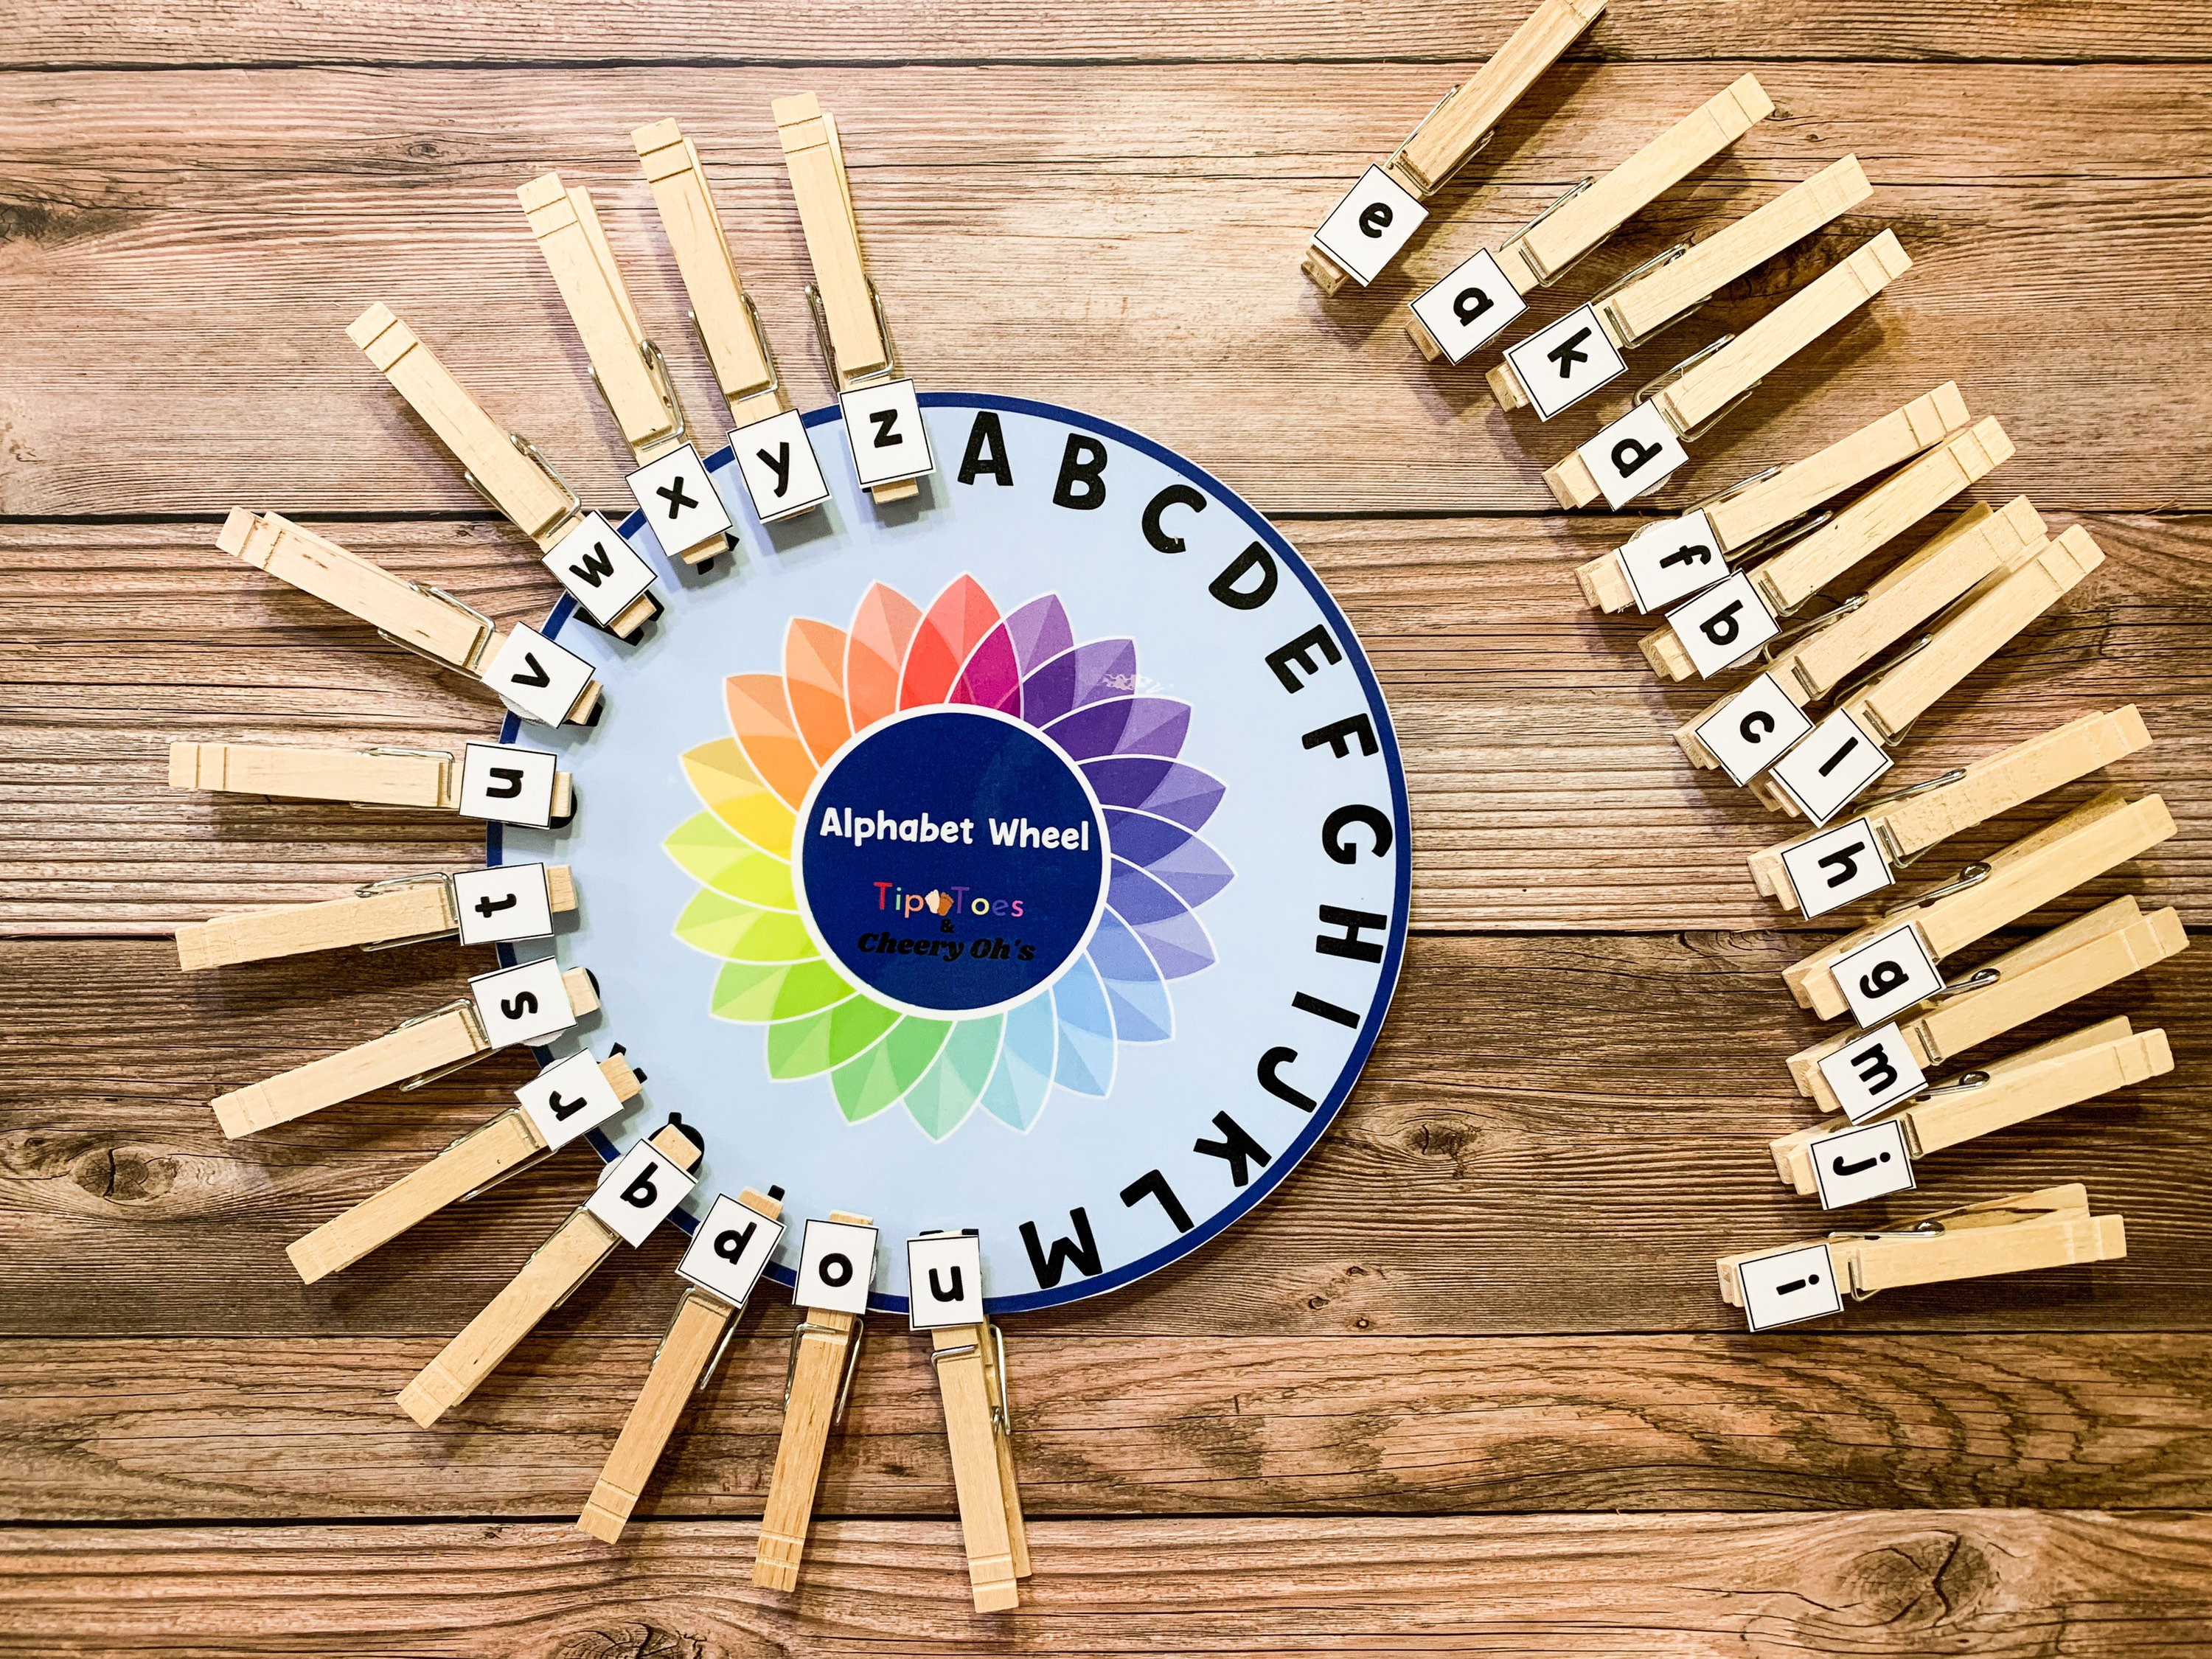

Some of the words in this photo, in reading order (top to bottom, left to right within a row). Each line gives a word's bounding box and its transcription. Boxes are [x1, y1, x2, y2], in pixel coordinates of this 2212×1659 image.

[1359, 203, 1393, 238] e
[1453, 288, 1494, 327] a
[1548, 327, 1591, 378] k
[870, 409, 902, 448] z
[958, 411, 1013, 486] A
[757, 442, 789, 497] y
[1053, 434, 1107, 509] B
[1612, 439, 1662, 478] d
[656, 476, 698, 519] x
[1142, 484, 1206, 553] C
[569, 542, 613, 588] w
[1209, 541, 1278, 610] D
[1660, 546, 1711, 568] f
[1700, 599, 1743, 645] b
[511, 653, 549, 687] v
[1265, 625, 1342, 693] E
[1302, 714, 1378, 758] F
[1740, 711, 1774, 743] c
[486, 768, 524, 798] u
[820, 807, 974, 846] Alphabet
[988, 818, 1088, 851] Wheel
[1323, 804, 1392, 864] G
[1818, 842, 1865, 888] h
[476, 894, 516, 918] t
[874, 882, 924, 918] Tip
[951, 886, 1023, 917] Toes
[858, 931, 965, 962] Cheery
[970, 937, 1036, 961] Oh's
[940, 918, 955, 933] &
[1316, 905, 1387, 963] H
[1860, 961, 1909, 998] g
[501, 992, 538, 1019] s
[1292, 992, 1360, 1029] I
[1258, 1047, 1316, 1113] J
[1851, 1043, 1897, 1095] m
[549, 1091, 587, 1121] r
[1194, 1111, 1272, 1187] K
[1833, 1152, 1891, 1175] j
[1120, 1169, 1194, 1233] L
[1019, 1207, 1102, 1289] M
[819, 1253, 852, 1287] o
[1776, 1275, 1819, 1295] i
